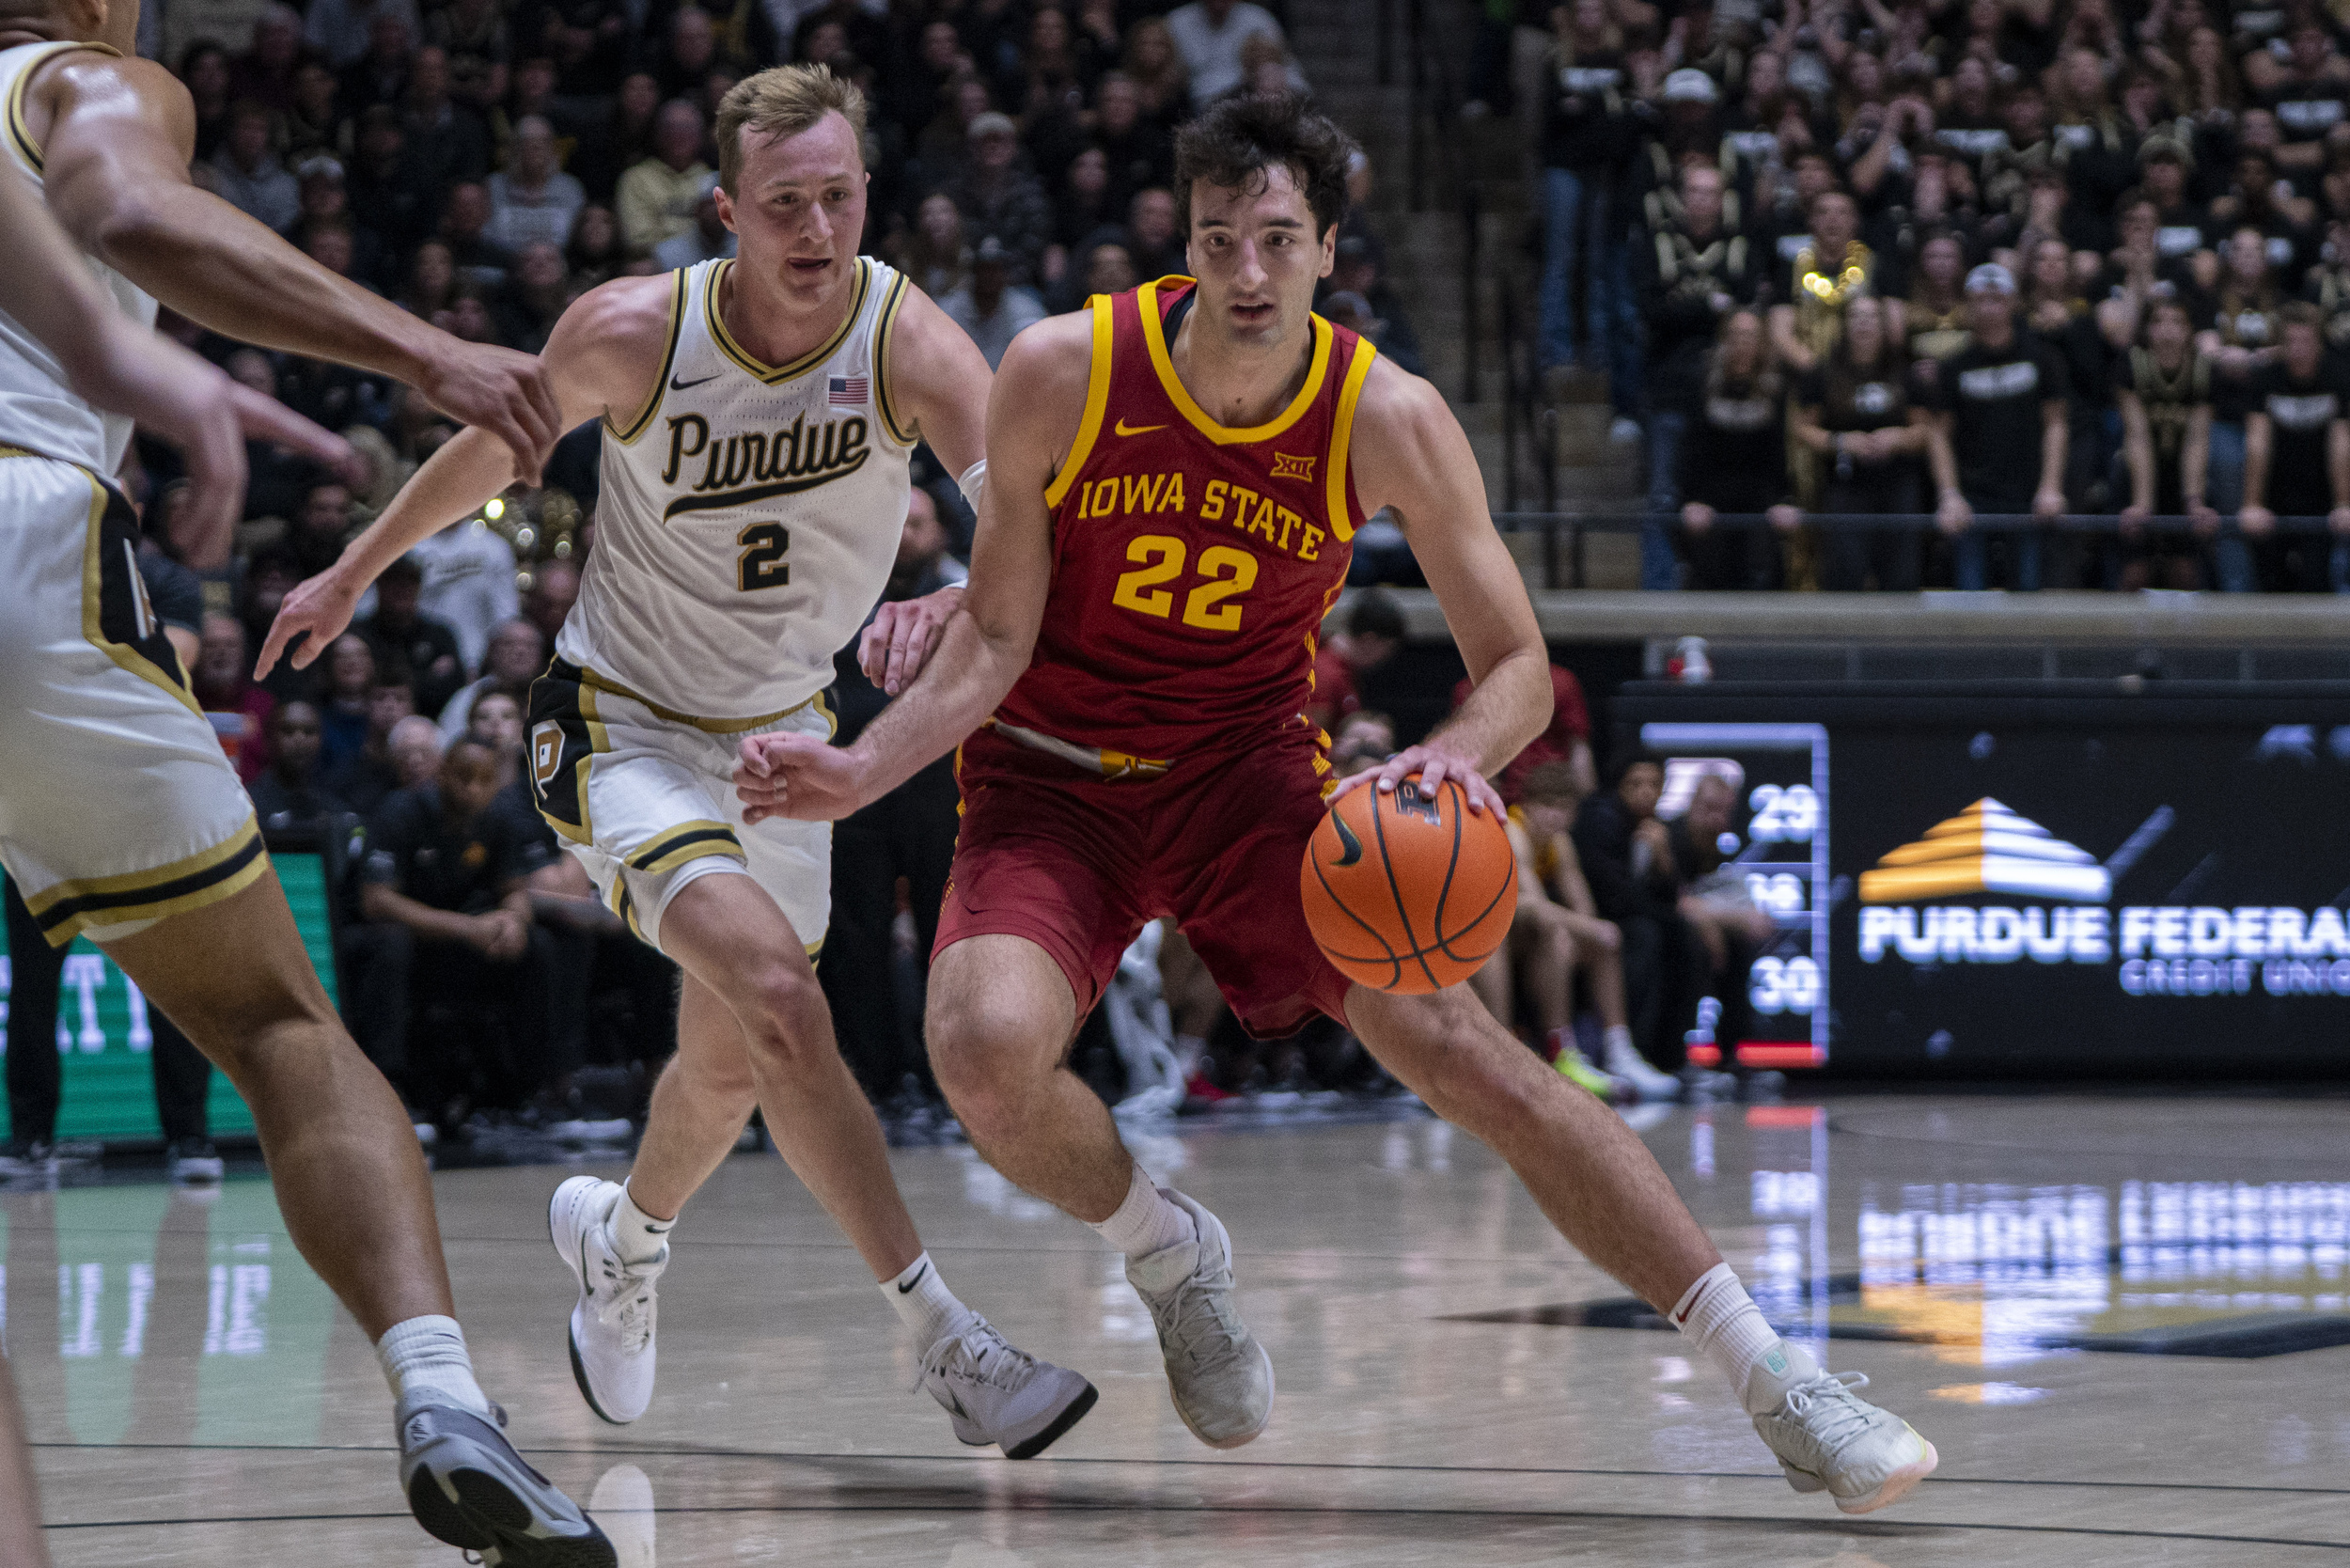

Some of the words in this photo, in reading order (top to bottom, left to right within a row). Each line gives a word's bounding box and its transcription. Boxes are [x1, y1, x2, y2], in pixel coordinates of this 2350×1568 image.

[661, 410, 871, 493] Purdue
[1077, 472, 1185, 520] IOWA
[1199, 479, 1325, 562] STATE
[737, 521, 790, 592] 2
[1112, 534, 1259, 633] 22
[1858, 905, 2112, 964] PURDUE
[2119, 905, 2350, 961] FEDERA
[1749, 955, 1820, 1015] 30
